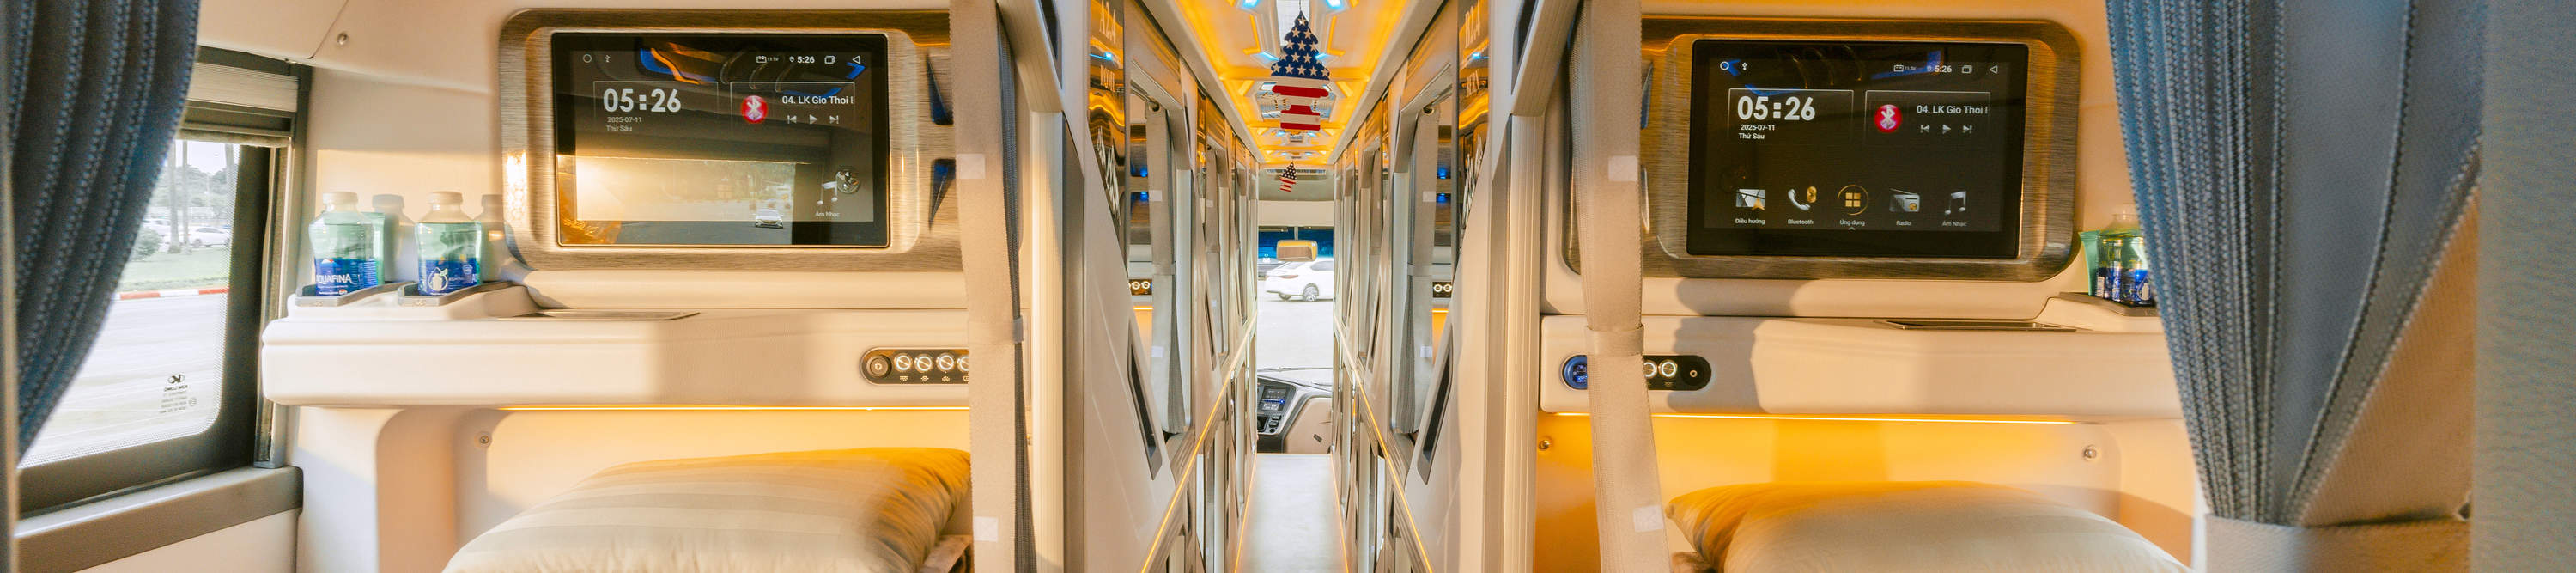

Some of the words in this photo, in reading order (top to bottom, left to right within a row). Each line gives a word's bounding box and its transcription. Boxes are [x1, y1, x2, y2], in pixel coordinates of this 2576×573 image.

[603, 88, 681, 113] 05:26
[1737, 95, 1815, 121] 05:26
[1916, 105, 1930, 113] 04.
[1932, 105, 1945, 113] LK
[1946, 105, 1962, 114] Gio
[1963, 105, 1984, 114] Thoi
